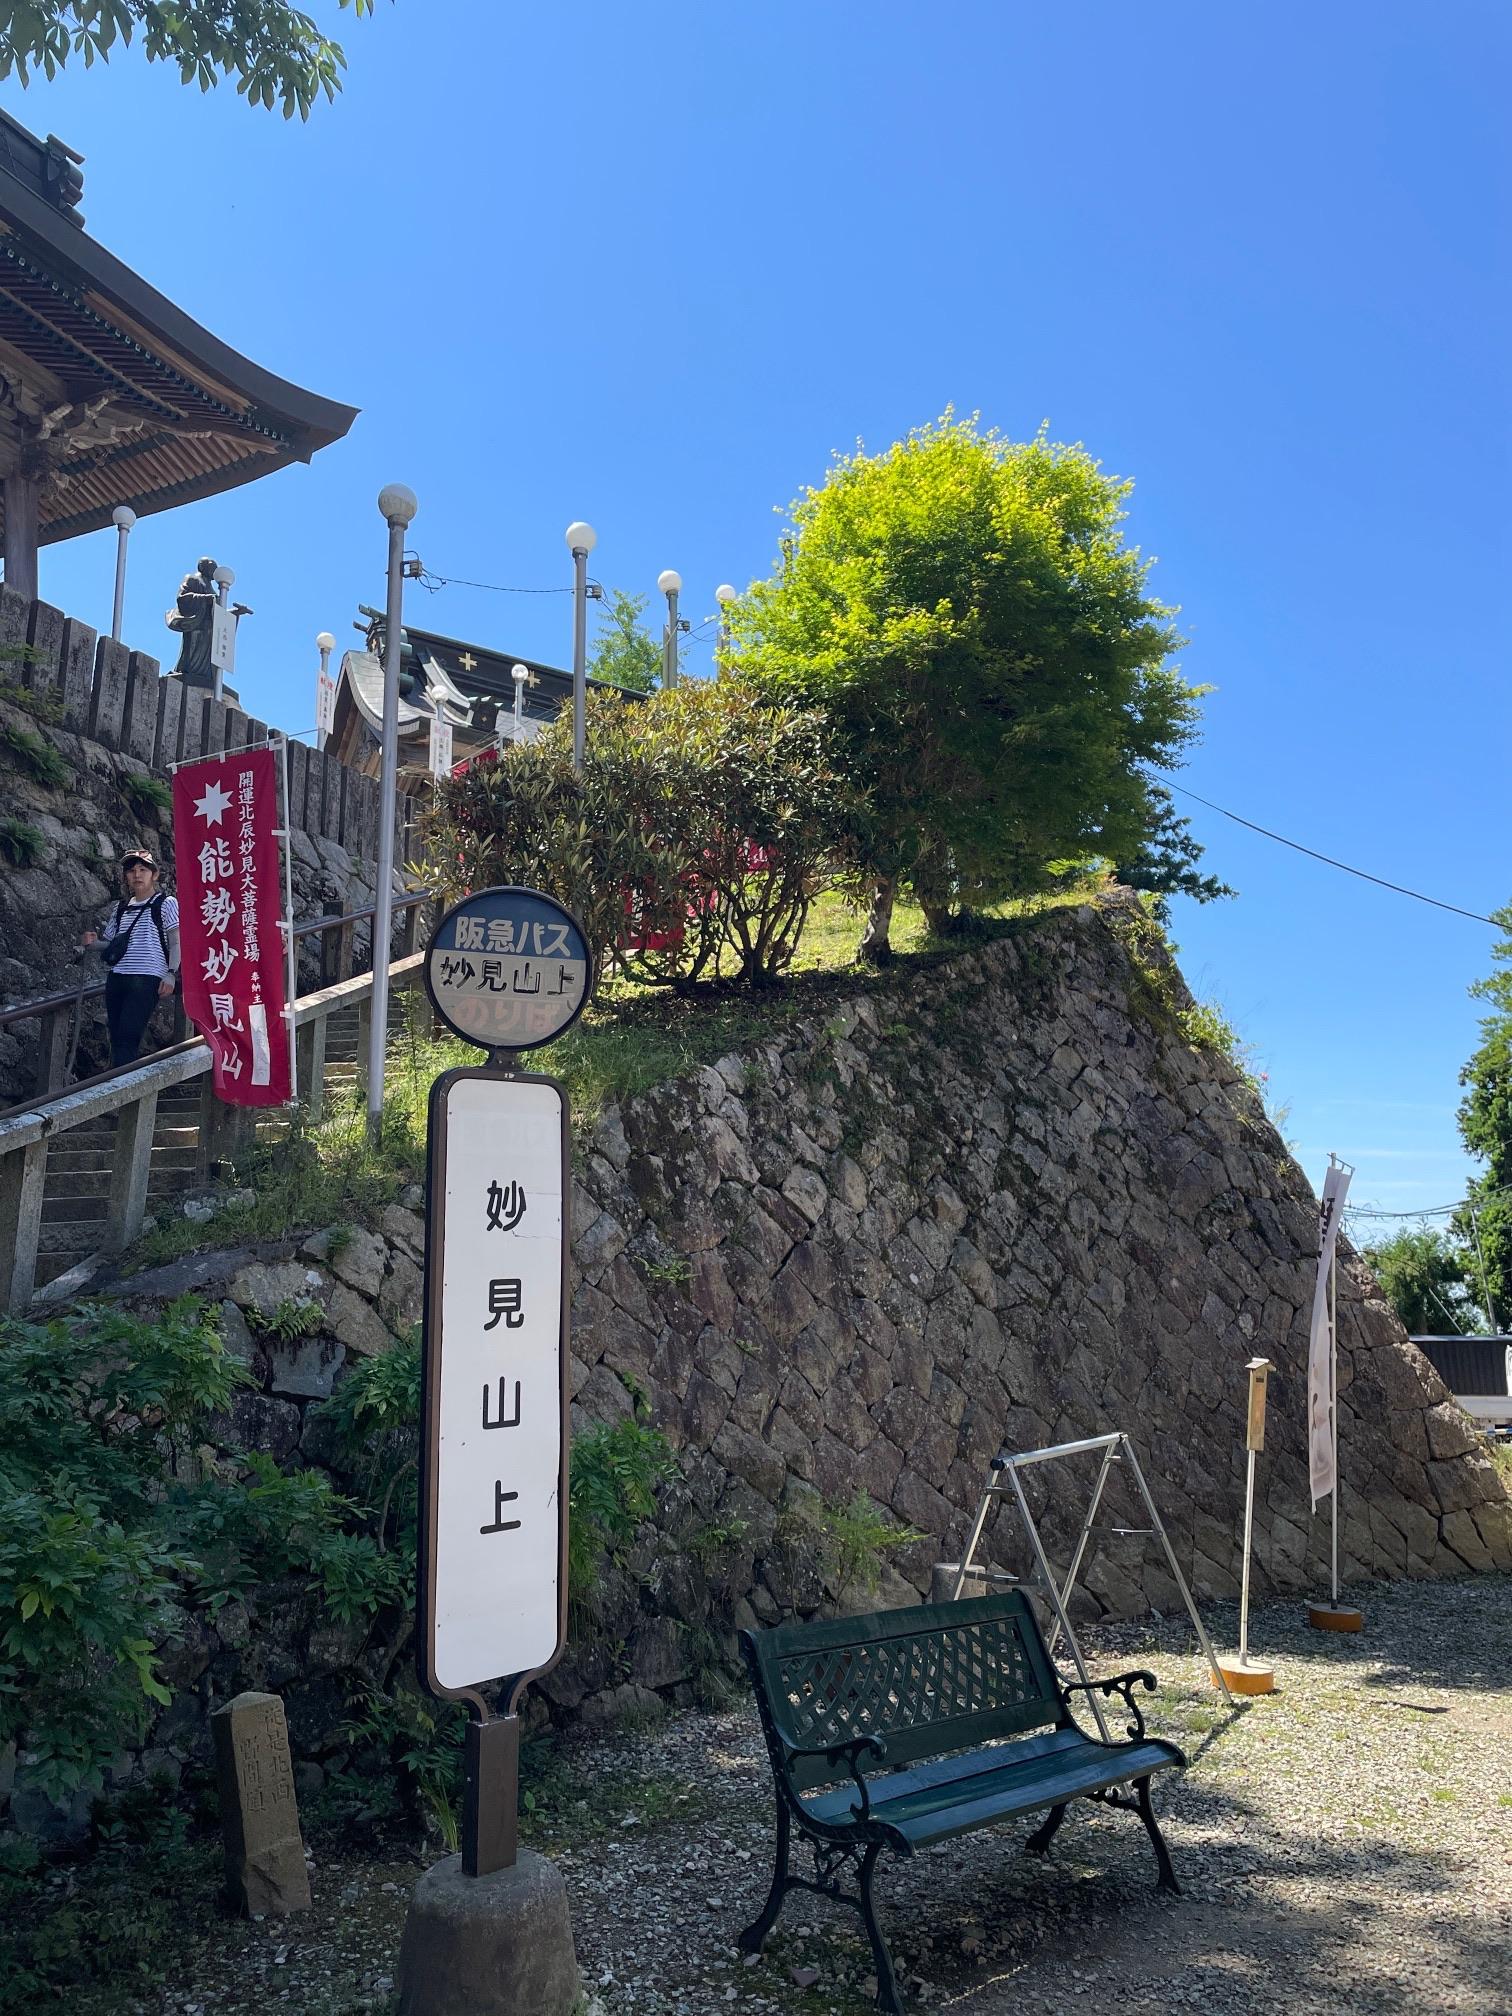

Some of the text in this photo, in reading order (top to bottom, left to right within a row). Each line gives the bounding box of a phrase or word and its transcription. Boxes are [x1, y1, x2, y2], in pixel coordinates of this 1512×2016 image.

[455, 916, 571, 957] 阪急バス
[198, 838, 244, 1080] 能勢妙見山
[440, 955, 575, 995] 妙見山上
[453, 997, 561, 1032] のりば
[480, 1179, 526, 1534] 妙見山上
